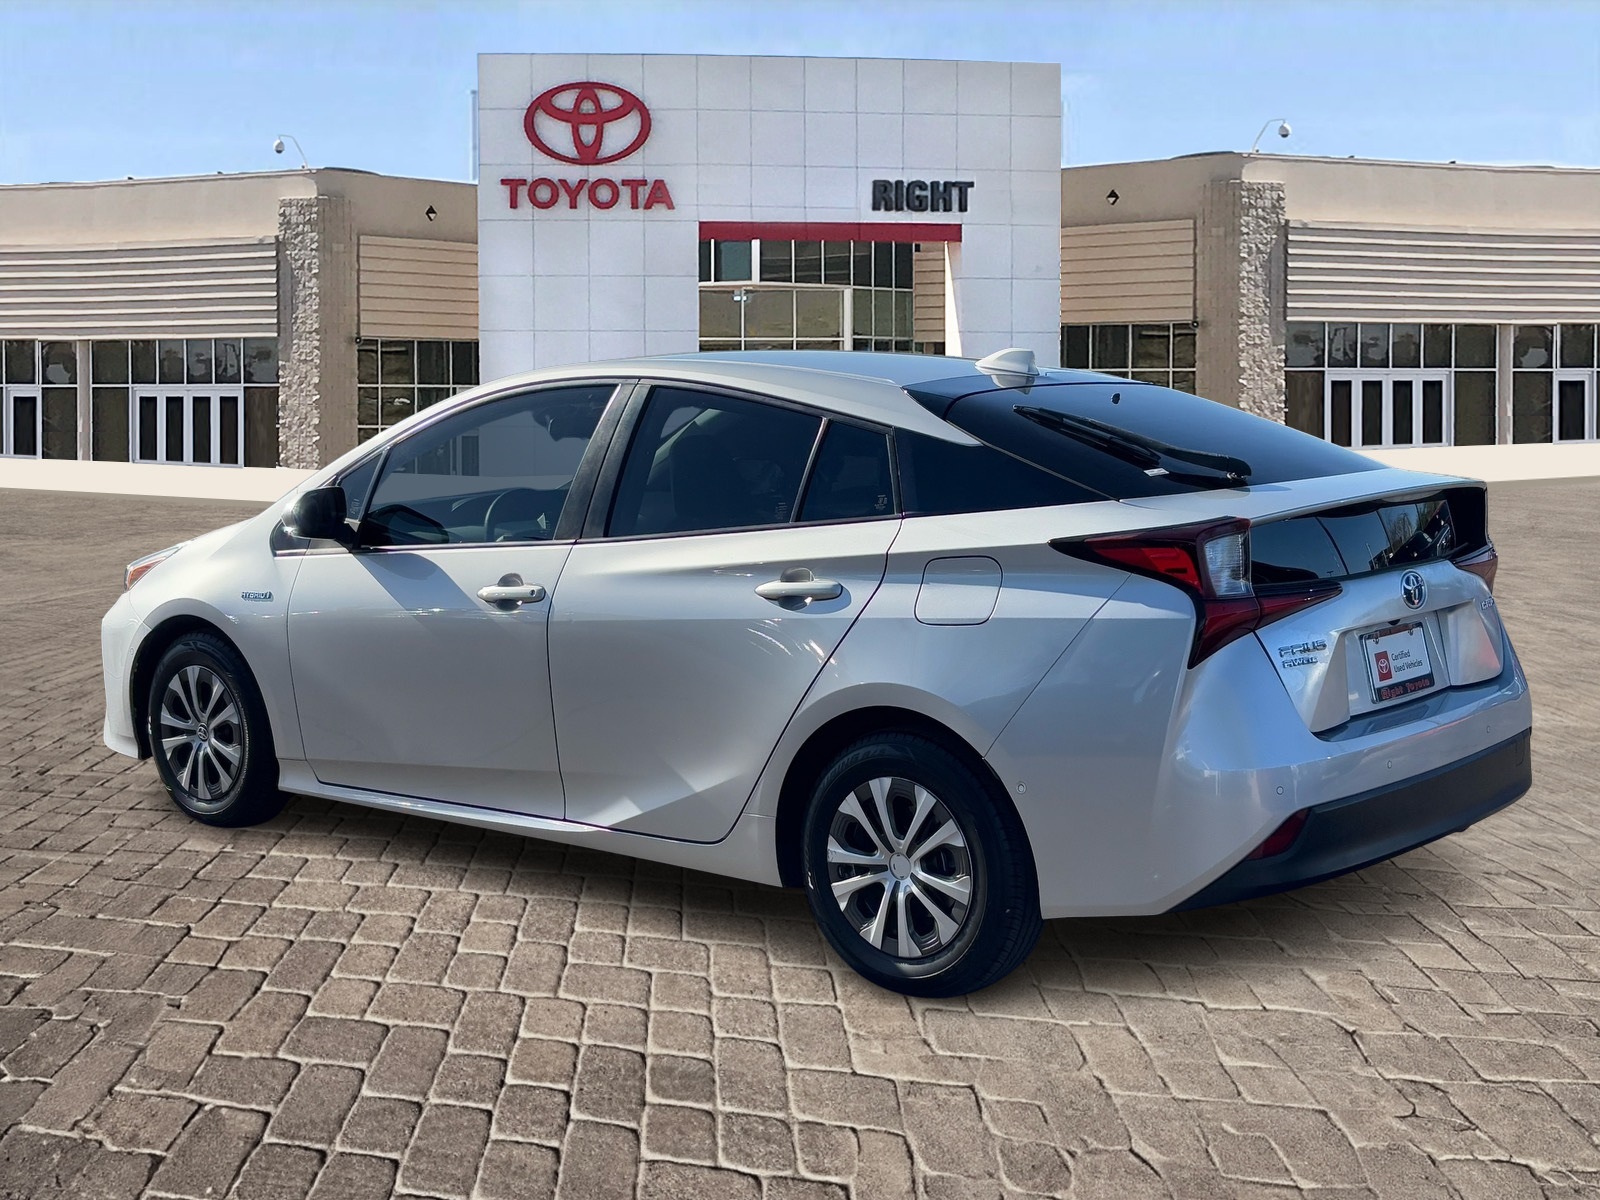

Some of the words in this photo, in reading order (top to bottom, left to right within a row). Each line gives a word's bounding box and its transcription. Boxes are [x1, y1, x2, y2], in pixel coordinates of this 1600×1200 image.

[500, 178, 676, 211] TOYOTA
[872, 179, 975, 213] RIGHT
[1391, 649, 1411, 661] Certified
[1394, 663, 1405, 673] Used
[1406, 659, 1423, 670] Vehicles
[1381, 684, 1403, 699] Right
[1405, 678, 1430, 693] Toyota
